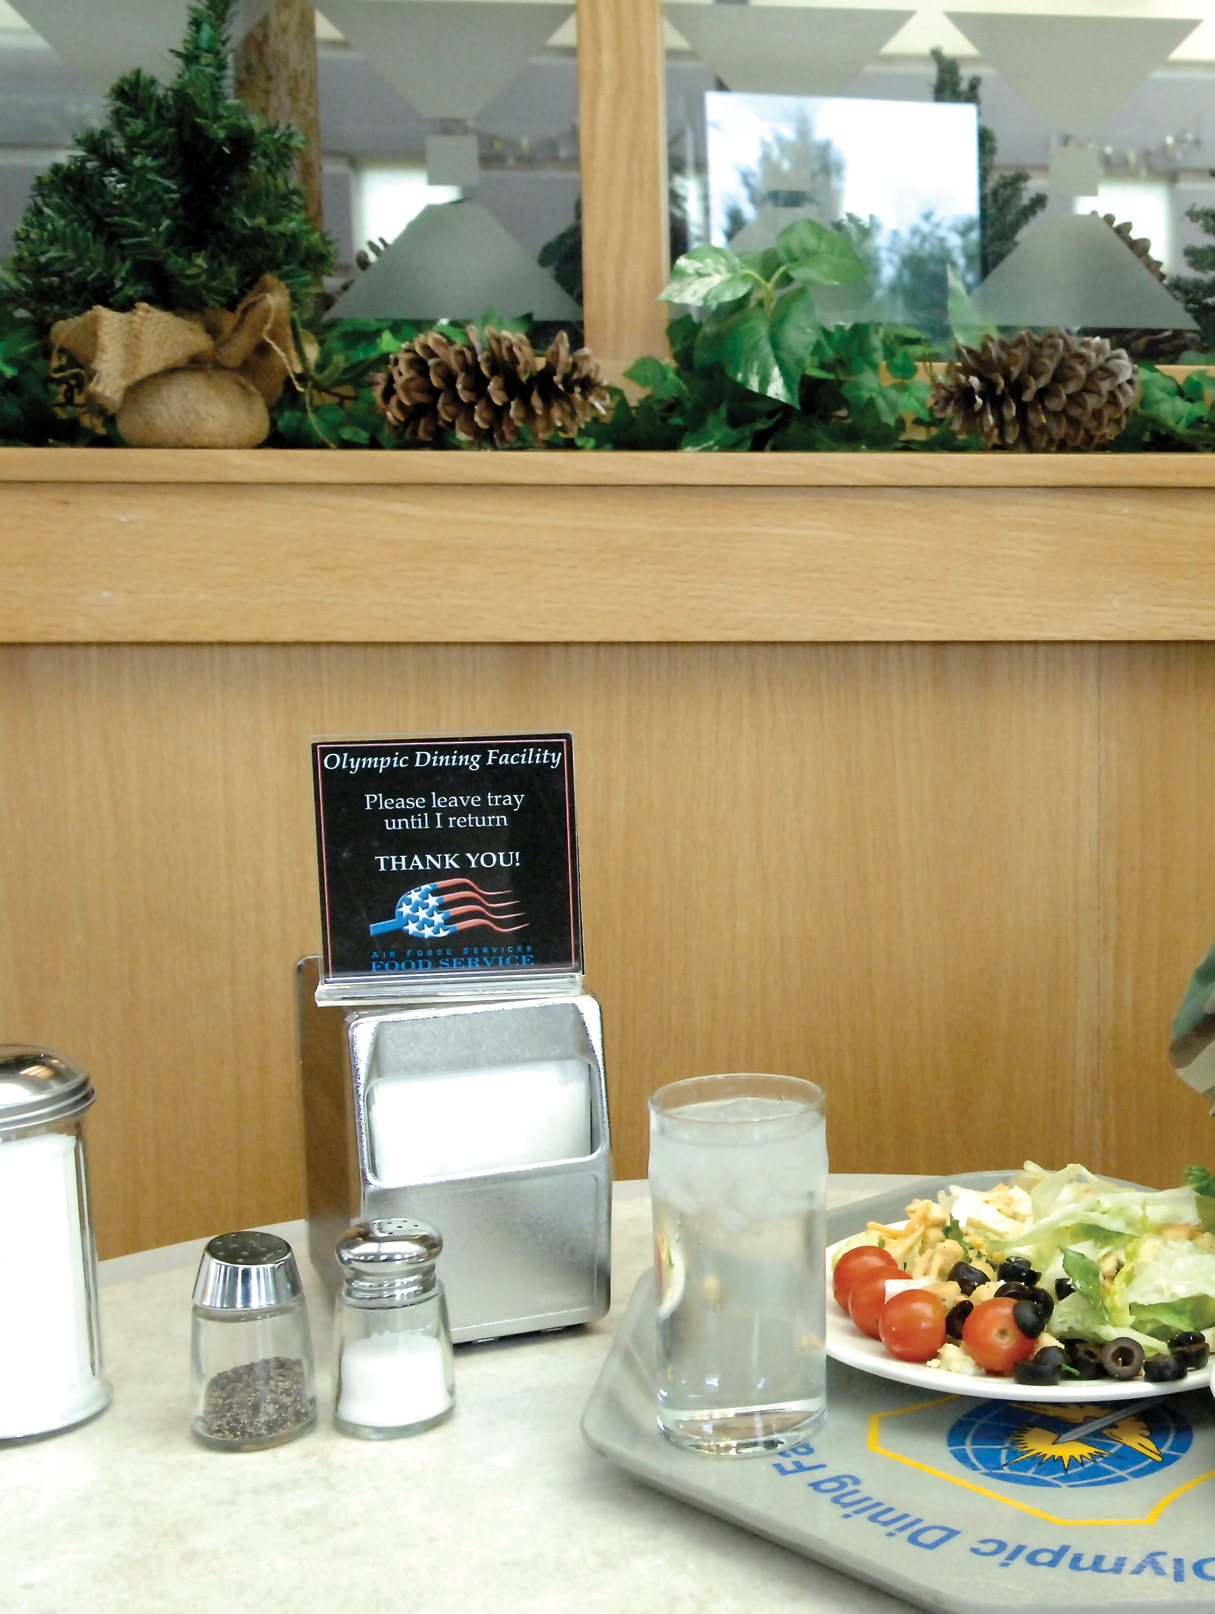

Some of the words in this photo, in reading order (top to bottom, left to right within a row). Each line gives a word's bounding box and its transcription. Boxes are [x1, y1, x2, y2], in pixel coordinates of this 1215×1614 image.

[323, 751, 409, 773] Olympic
[414, 750, 482, 771] Dining
[486, 748, 562, 769] Facility
[364, 793, 426, 811] Please
[431, 792, 482, 808] leave
[487, 792, 525, 811] tray
[384, 813, 430, 830] until
[435, 813, 443, 829] I
[449, 812, 509, 828] return
[374, 853, 461, 872] THANK
[465, 851, 521, 869] YOU!
[371, 950, 397, 959] AIR
[406, 948, 452, 957] FORCE
[463, 945, 534, 955] SERVICES
[371, 958, 433, 973] FOOD
[438, 954, 535, 970] SERVICE
[807, 1474, 962, 1551] Dining
